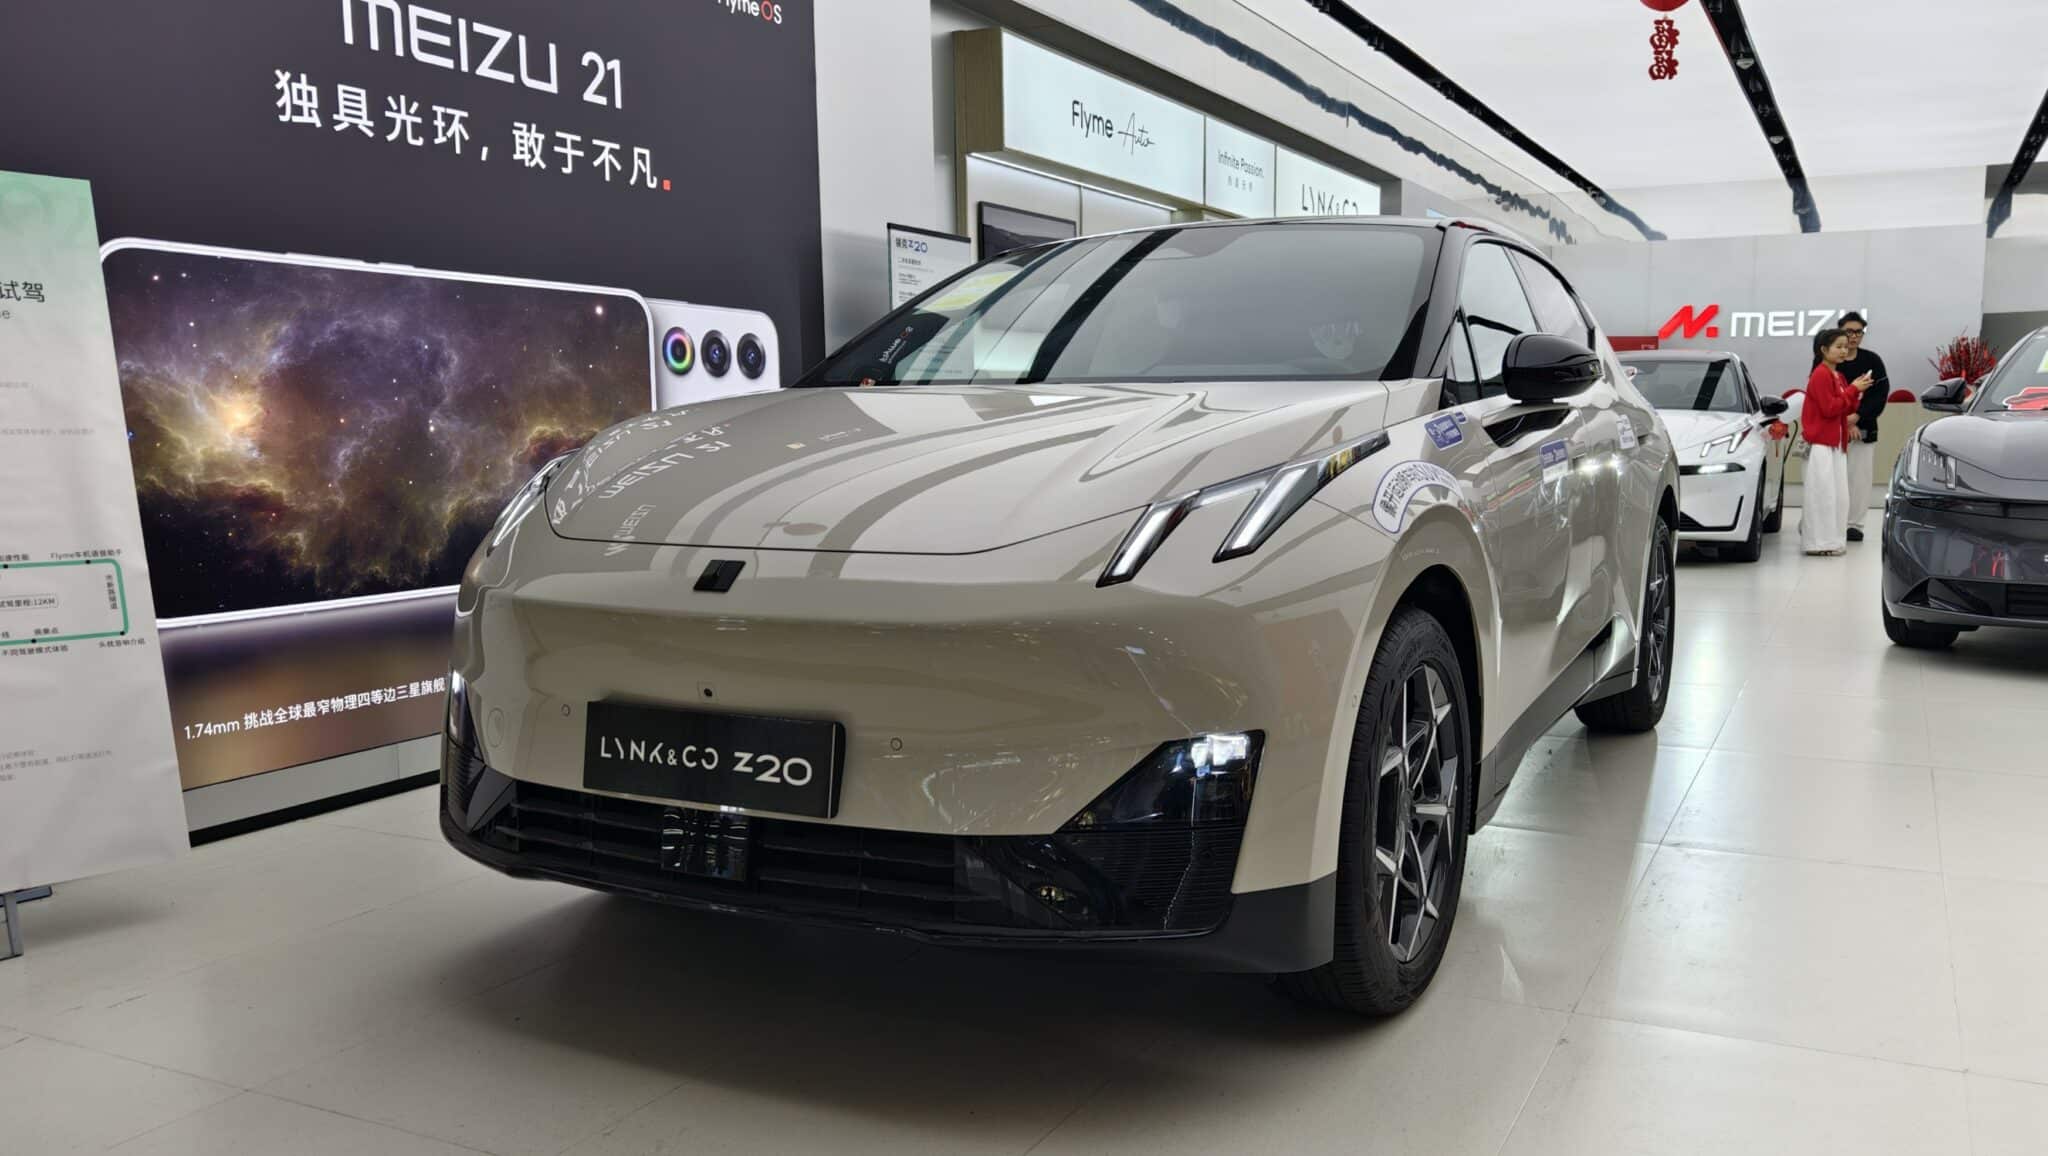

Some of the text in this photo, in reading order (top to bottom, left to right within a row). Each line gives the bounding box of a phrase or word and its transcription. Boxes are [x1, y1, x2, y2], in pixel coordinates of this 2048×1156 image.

[342, 0, 623, 109] MEIZU 21
[1071, 100, 1113, 139] Flyme
[1217, 150, 1240, 169] Infinite
[183, 718, 240, 741] 1.74mm
